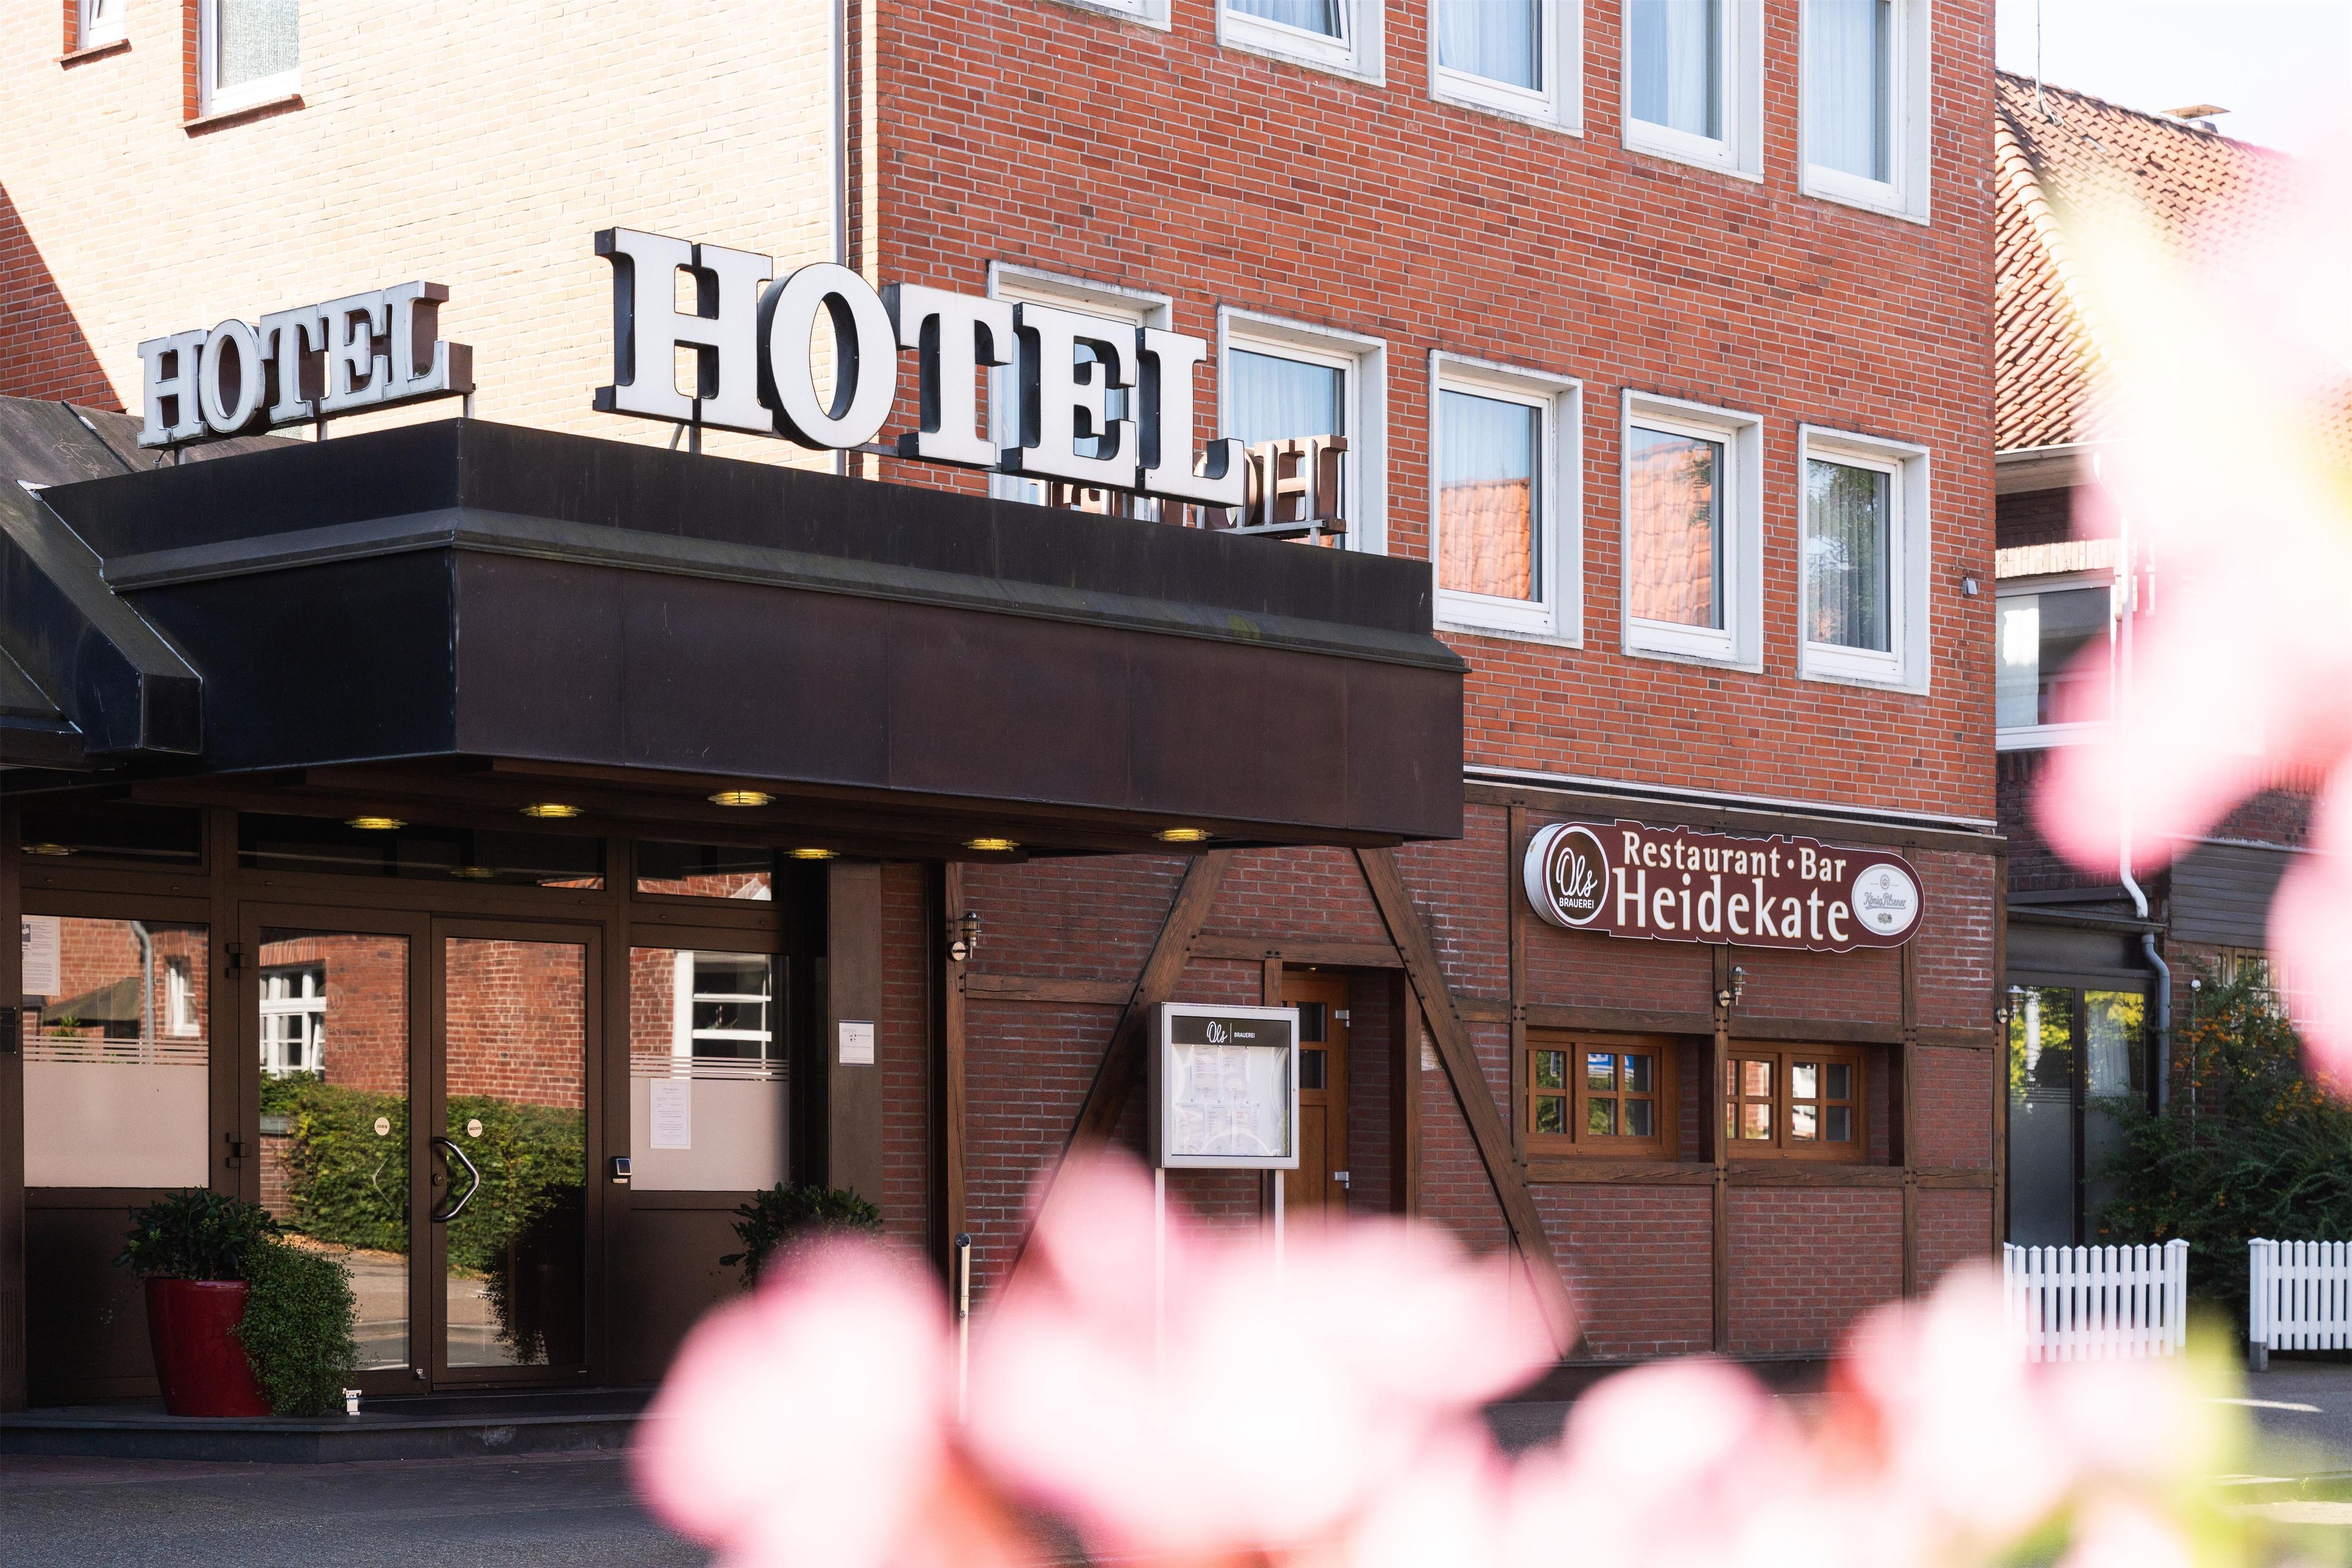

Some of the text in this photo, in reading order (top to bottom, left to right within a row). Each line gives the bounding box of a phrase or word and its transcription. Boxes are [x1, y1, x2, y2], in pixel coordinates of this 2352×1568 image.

[137, 280, 473, 450] HOTEL
[594, 226, 1245, 508] HOTEL
[1556, 847, 1598, 897] Ols
[1622, 830, 1846, 883] Restaurant Bar
[1559, 897, 1594, 909] BRAUEREI
[1612, 866, 1849, 942] Heidekate
[1863, 892, 1907, 908] König Pilsener
[1207, 1021, 1227, 1043] Ols
